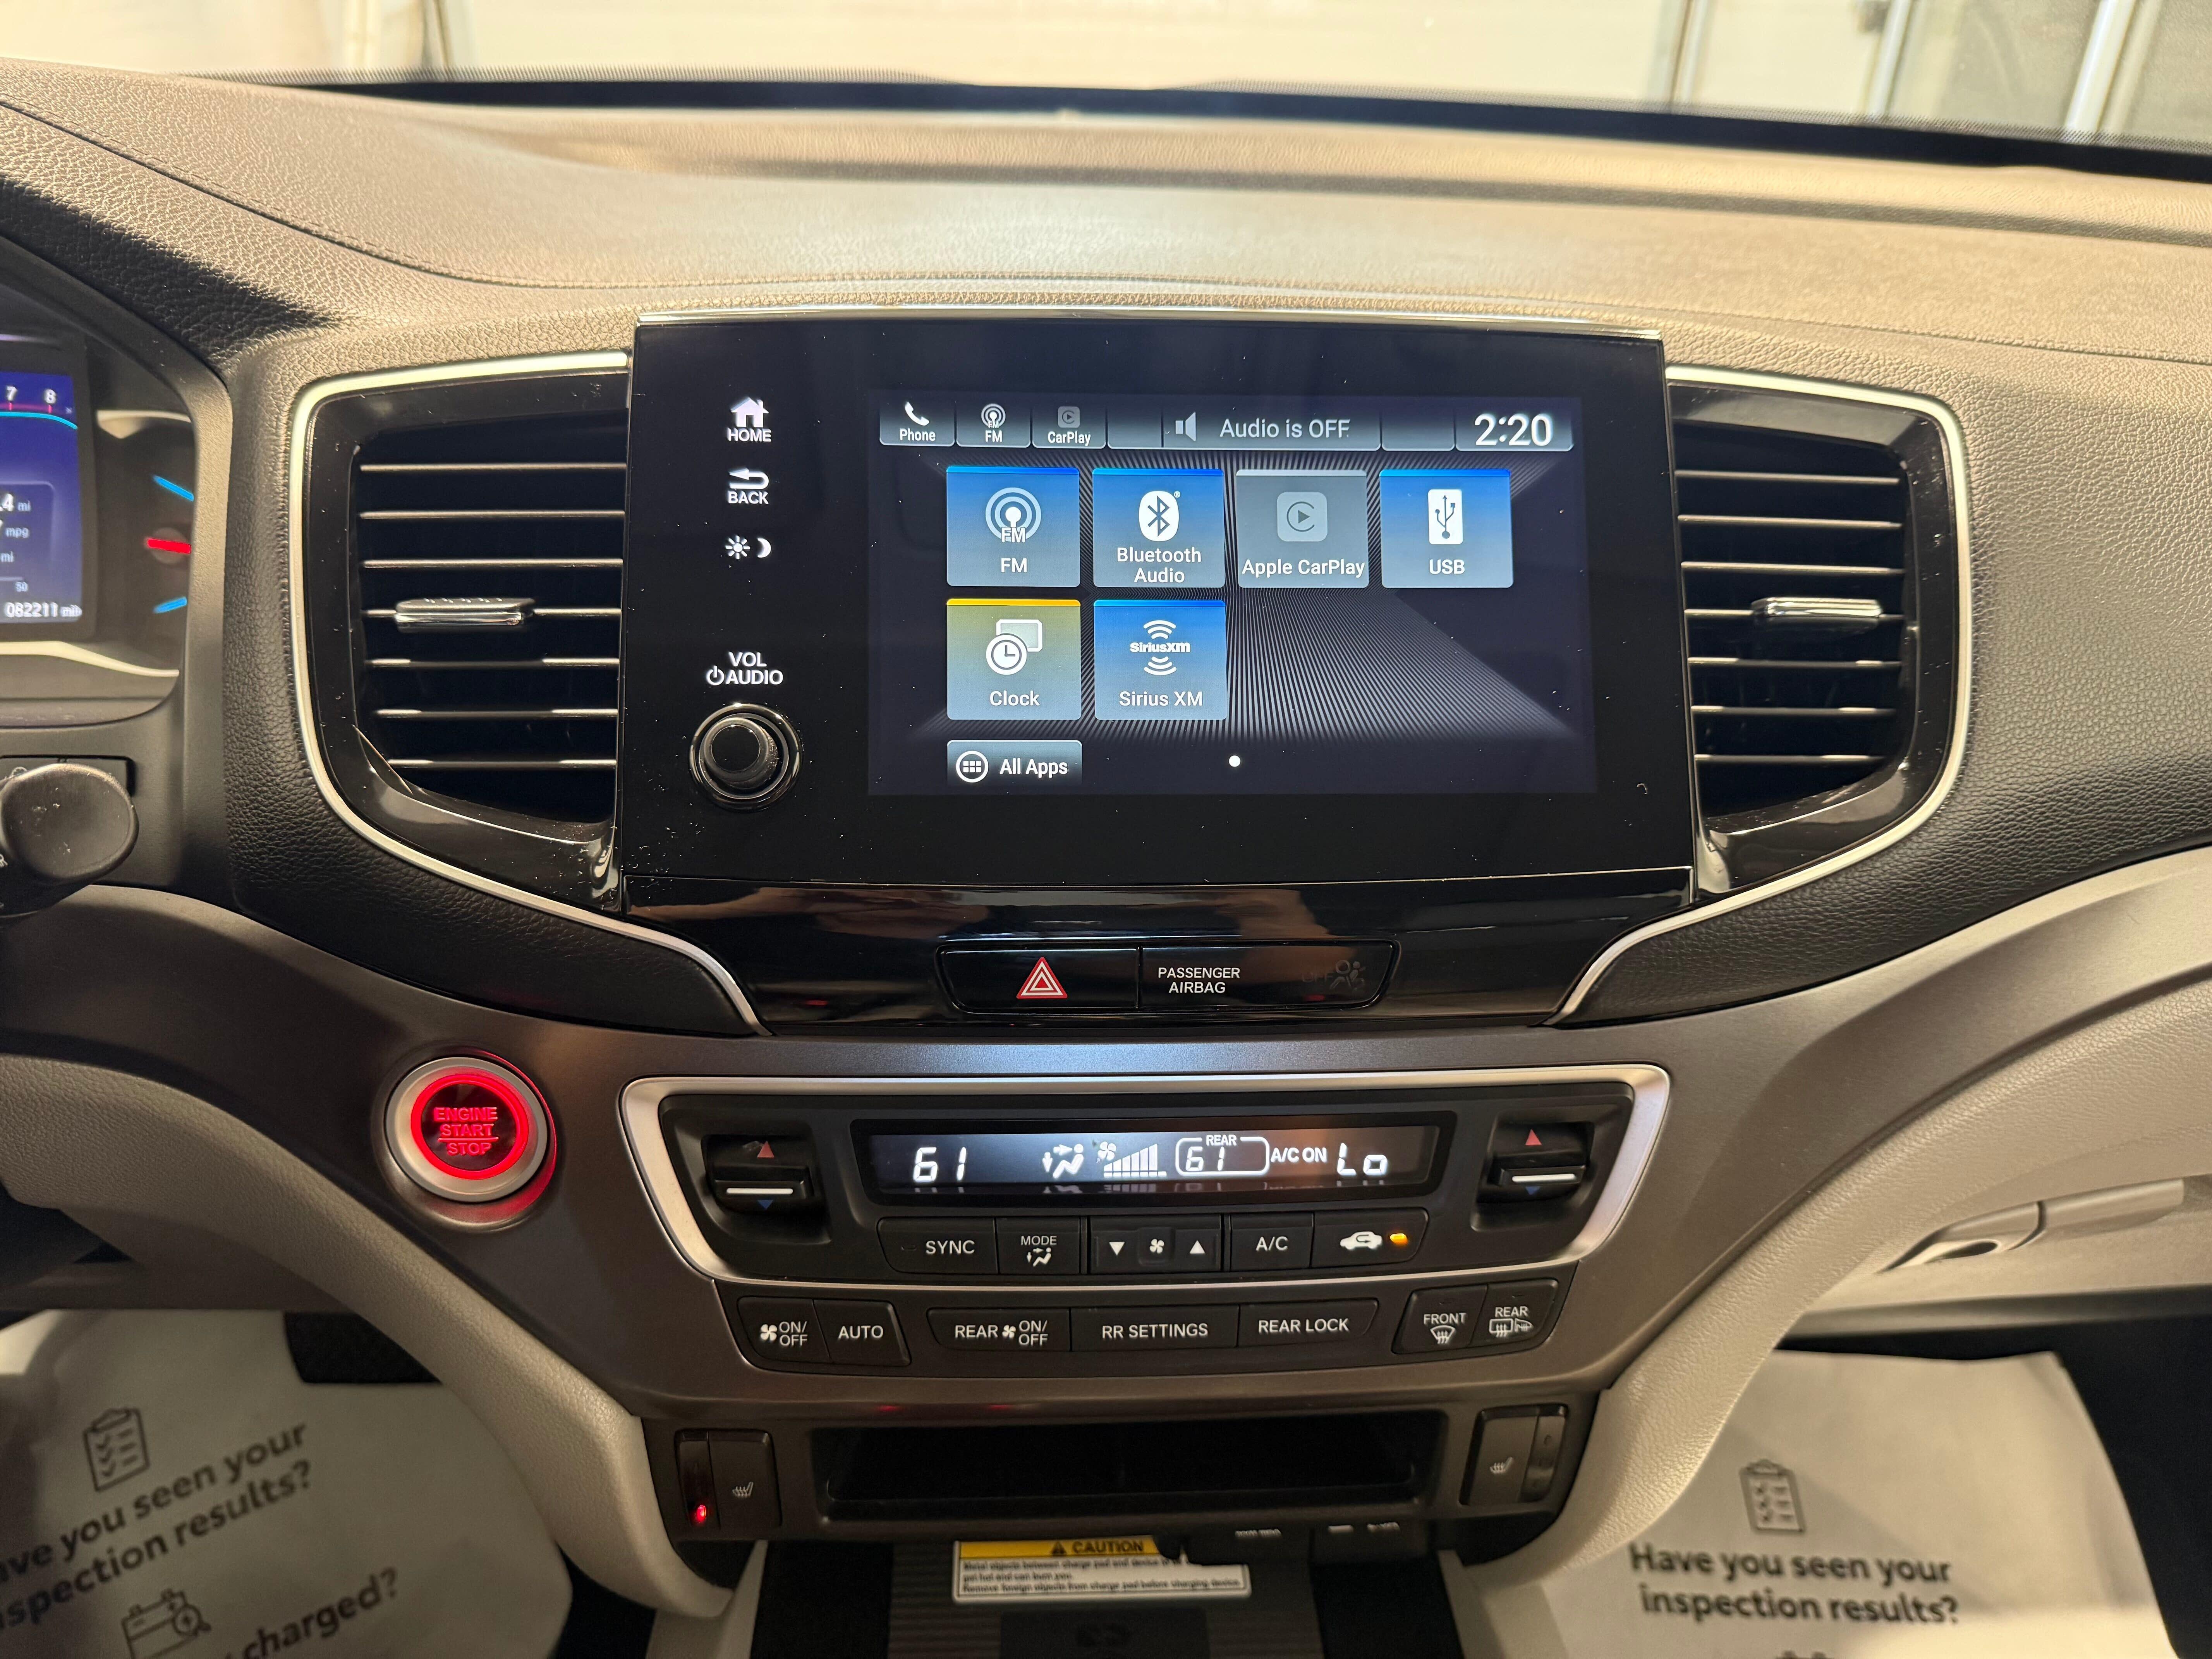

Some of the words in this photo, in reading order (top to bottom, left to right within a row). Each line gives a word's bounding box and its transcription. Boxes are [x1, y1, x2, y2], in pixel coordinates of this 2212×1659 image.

[6, 386, 17, 401] 7
[44, 389, 57, 404] 8
[727, 428, 771, 442] HOME
[900, 428, 936, 441] Phone
[1219, 418, 1279, 438] Audio
[1286, 419, 1302, 438] is
[1309, 419, 1350, 438] OFF
[1475, 414, 1553, 446] 2:20
[985, 430, 1002, 442] FM
[1048, 431, 1091, 445] CarPlay
[728, 491, 769, 504] BACK
[17, 500, 31, 512] mi
[5, 527, 30, 538] mpg
[1000, 527, 1027, 543] FM
[1117, 546, 1201, 563] Bluetooth
[1001, 558, 1027, 573] FM
[1242, 558, 1292, 578] Apple
[1298, 558, 1365, 578] CarPlay
[1429, 559, 1465, 574] USB
[1134, 567, 1185, 583] Audio
[5, 602, 58, 617] 082211
[728, 652, 767, 667] VOL
[725, 670, 783, 685] AUDIO
[990, 690, 1040, 706] Clock
[1119, 691, 1169, 706] Sirius
[1174, 691, 1202, 706] XM
[1000, 758, 1021, 775] All
[1026, 758, 1068, 778] Apps
[1158, 967, 1240, 978] PASSENGER
[1168, 982, 1225, 993] AIRBAG
[433, 1107, 498, 1123] ENGINE
[440, 1123, 494, 1137] START
[1206, 1134, 1237, 1146] REAR
[447, 1142, 492, 1156] STOP
[1270, 1147, 1299, 1163] A/C
[1302, 1147, 1327, 1163] ON
[913, 1147, 967, 1182] 61
[1185, 1146, 1225, 1171] 61
[1337, 1142, 1388, 1176] Lo
[926, 1240, 975, 1254] SYNC
[1021, 1235, 1057, 1245] MODE
[1256, 1236, 1288, 1251] A/C
[1424, 1312, 1466, 1323] FRONT
[1495, 1306, 1528, 1317] REAR
[779, 1321, 807, 1333] ON/
[838, 1325, 883, 1339] AUTO
[955, 1325, 998, 1338] REAR
[1019, 1320, 1048, 1332] ON/
[1102, 1325, 1123, 1339] RR
[1129, 1323, 1208, 1338] SETTINGS
[1259, 1319, 1300, 1333] REAR
[1305, 1318, 1349, 1332] LOCK
[780, 1334, 808, 1346] OFF
[1018, 1334, 1048, 1345] OFF
[60, 1507, 126, 1562] you
[133, 1465, 216, 1520] seen
[223, 1423, 306, 1484] your
[174, 1459, 311, 1546] results?
[1072, 1540, 1144, 1554] CAUTION
[1629, 1542, 1715, 1574] Have
[1723, 1553, 1783, 1582] you
[1793, 1554, 1868, 1581] seen
[1875, 1558, 1951, 1588] your
[1639, 1583, 1822, 1623] inspection
[1829, 1592, 1959, 1625] results?
[243, 1566, 397, 1659] charged?
